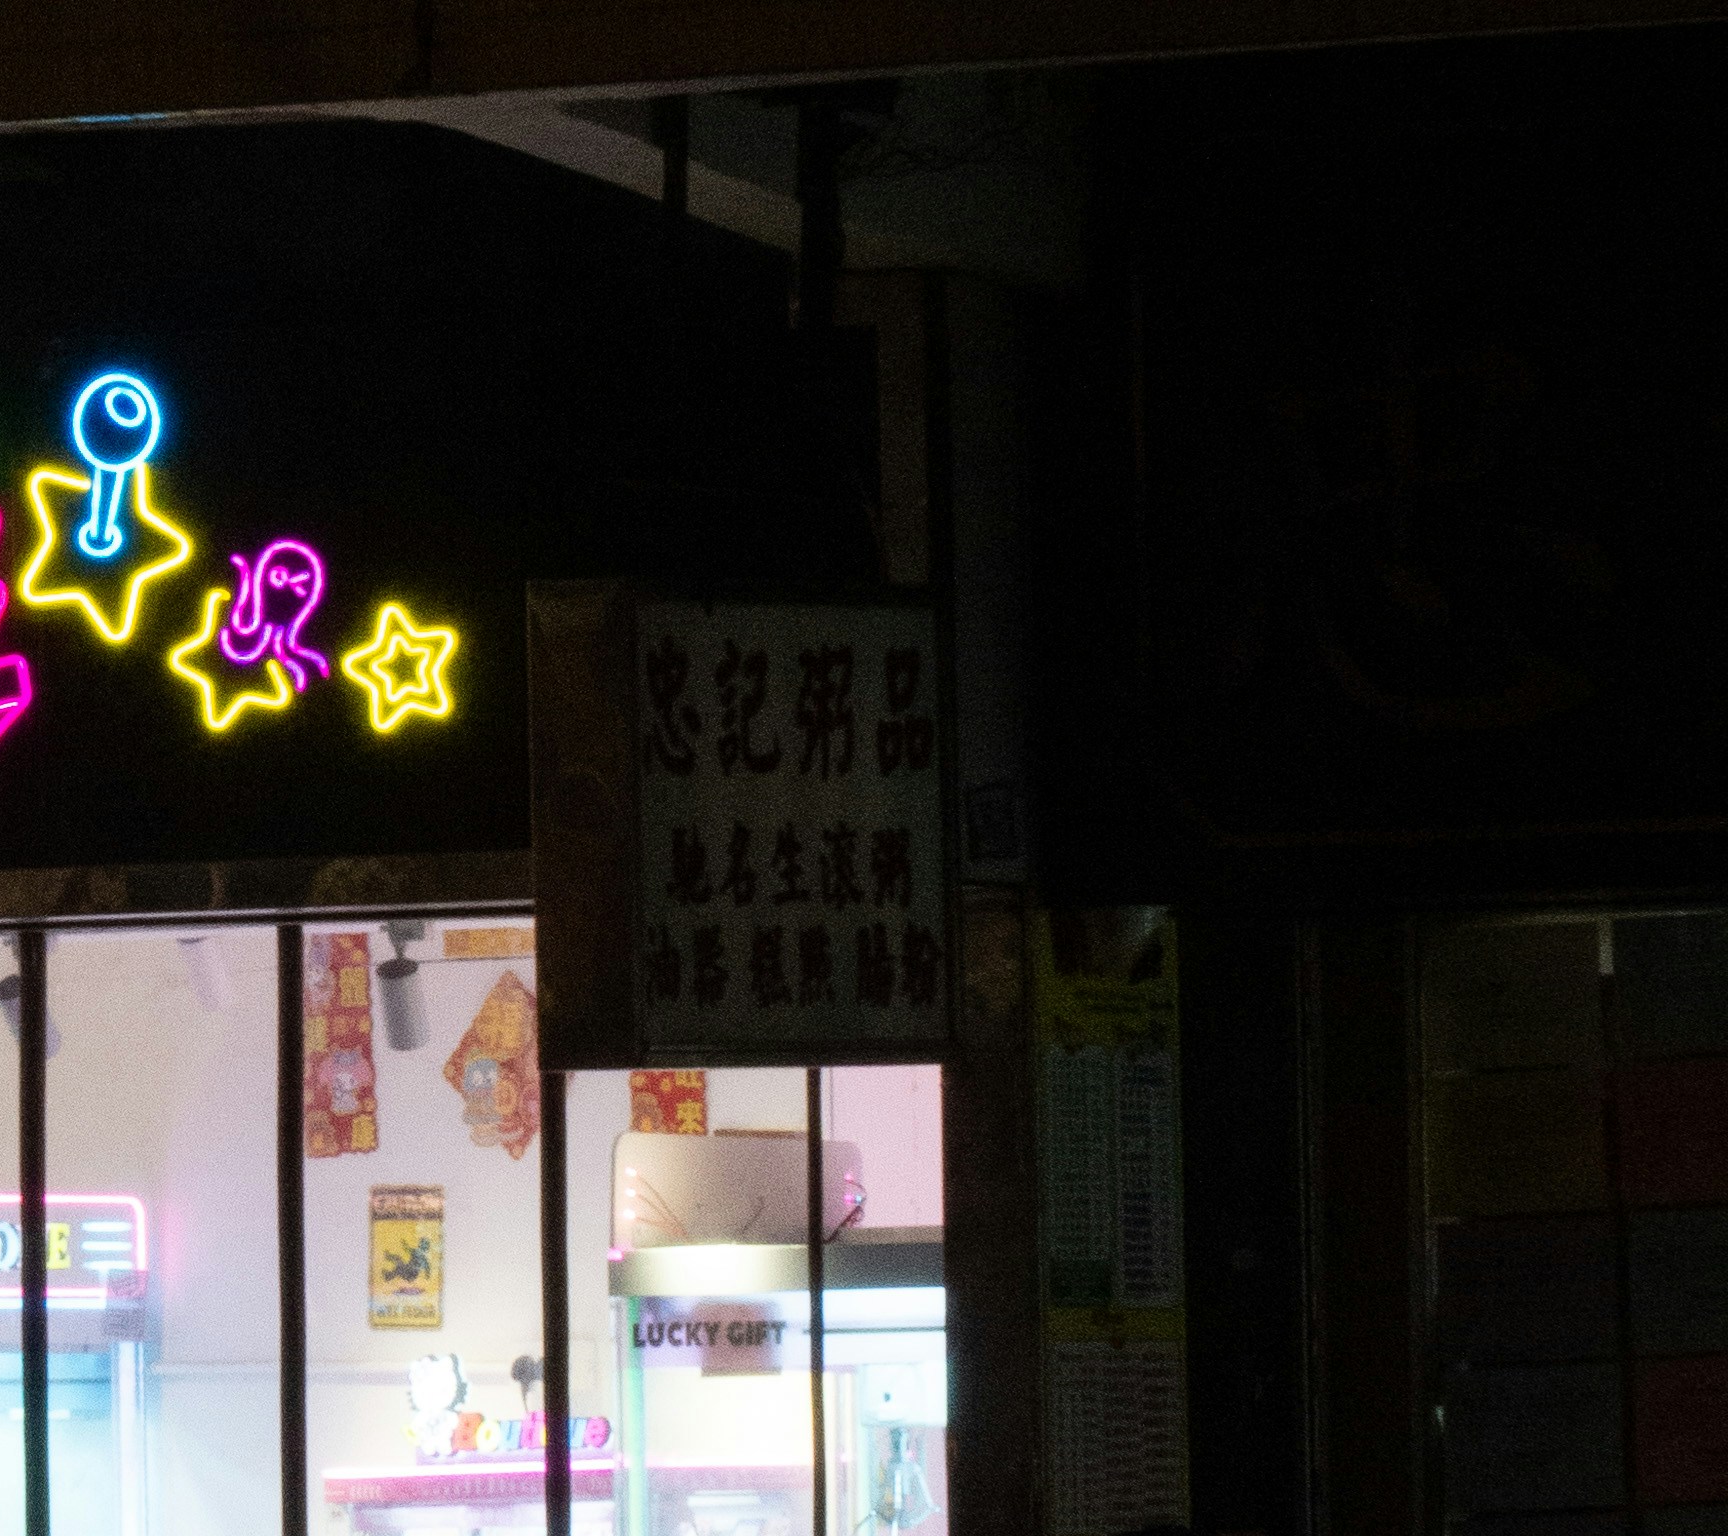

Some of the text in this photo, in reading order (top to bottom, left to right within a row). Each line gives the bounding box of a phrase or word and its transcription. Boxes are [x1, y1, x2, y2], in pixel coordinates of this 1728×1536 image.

[643, 635, 934, 780] 忠記粥品
[632, 1319, 788, 1348] LUCKY GIFT
